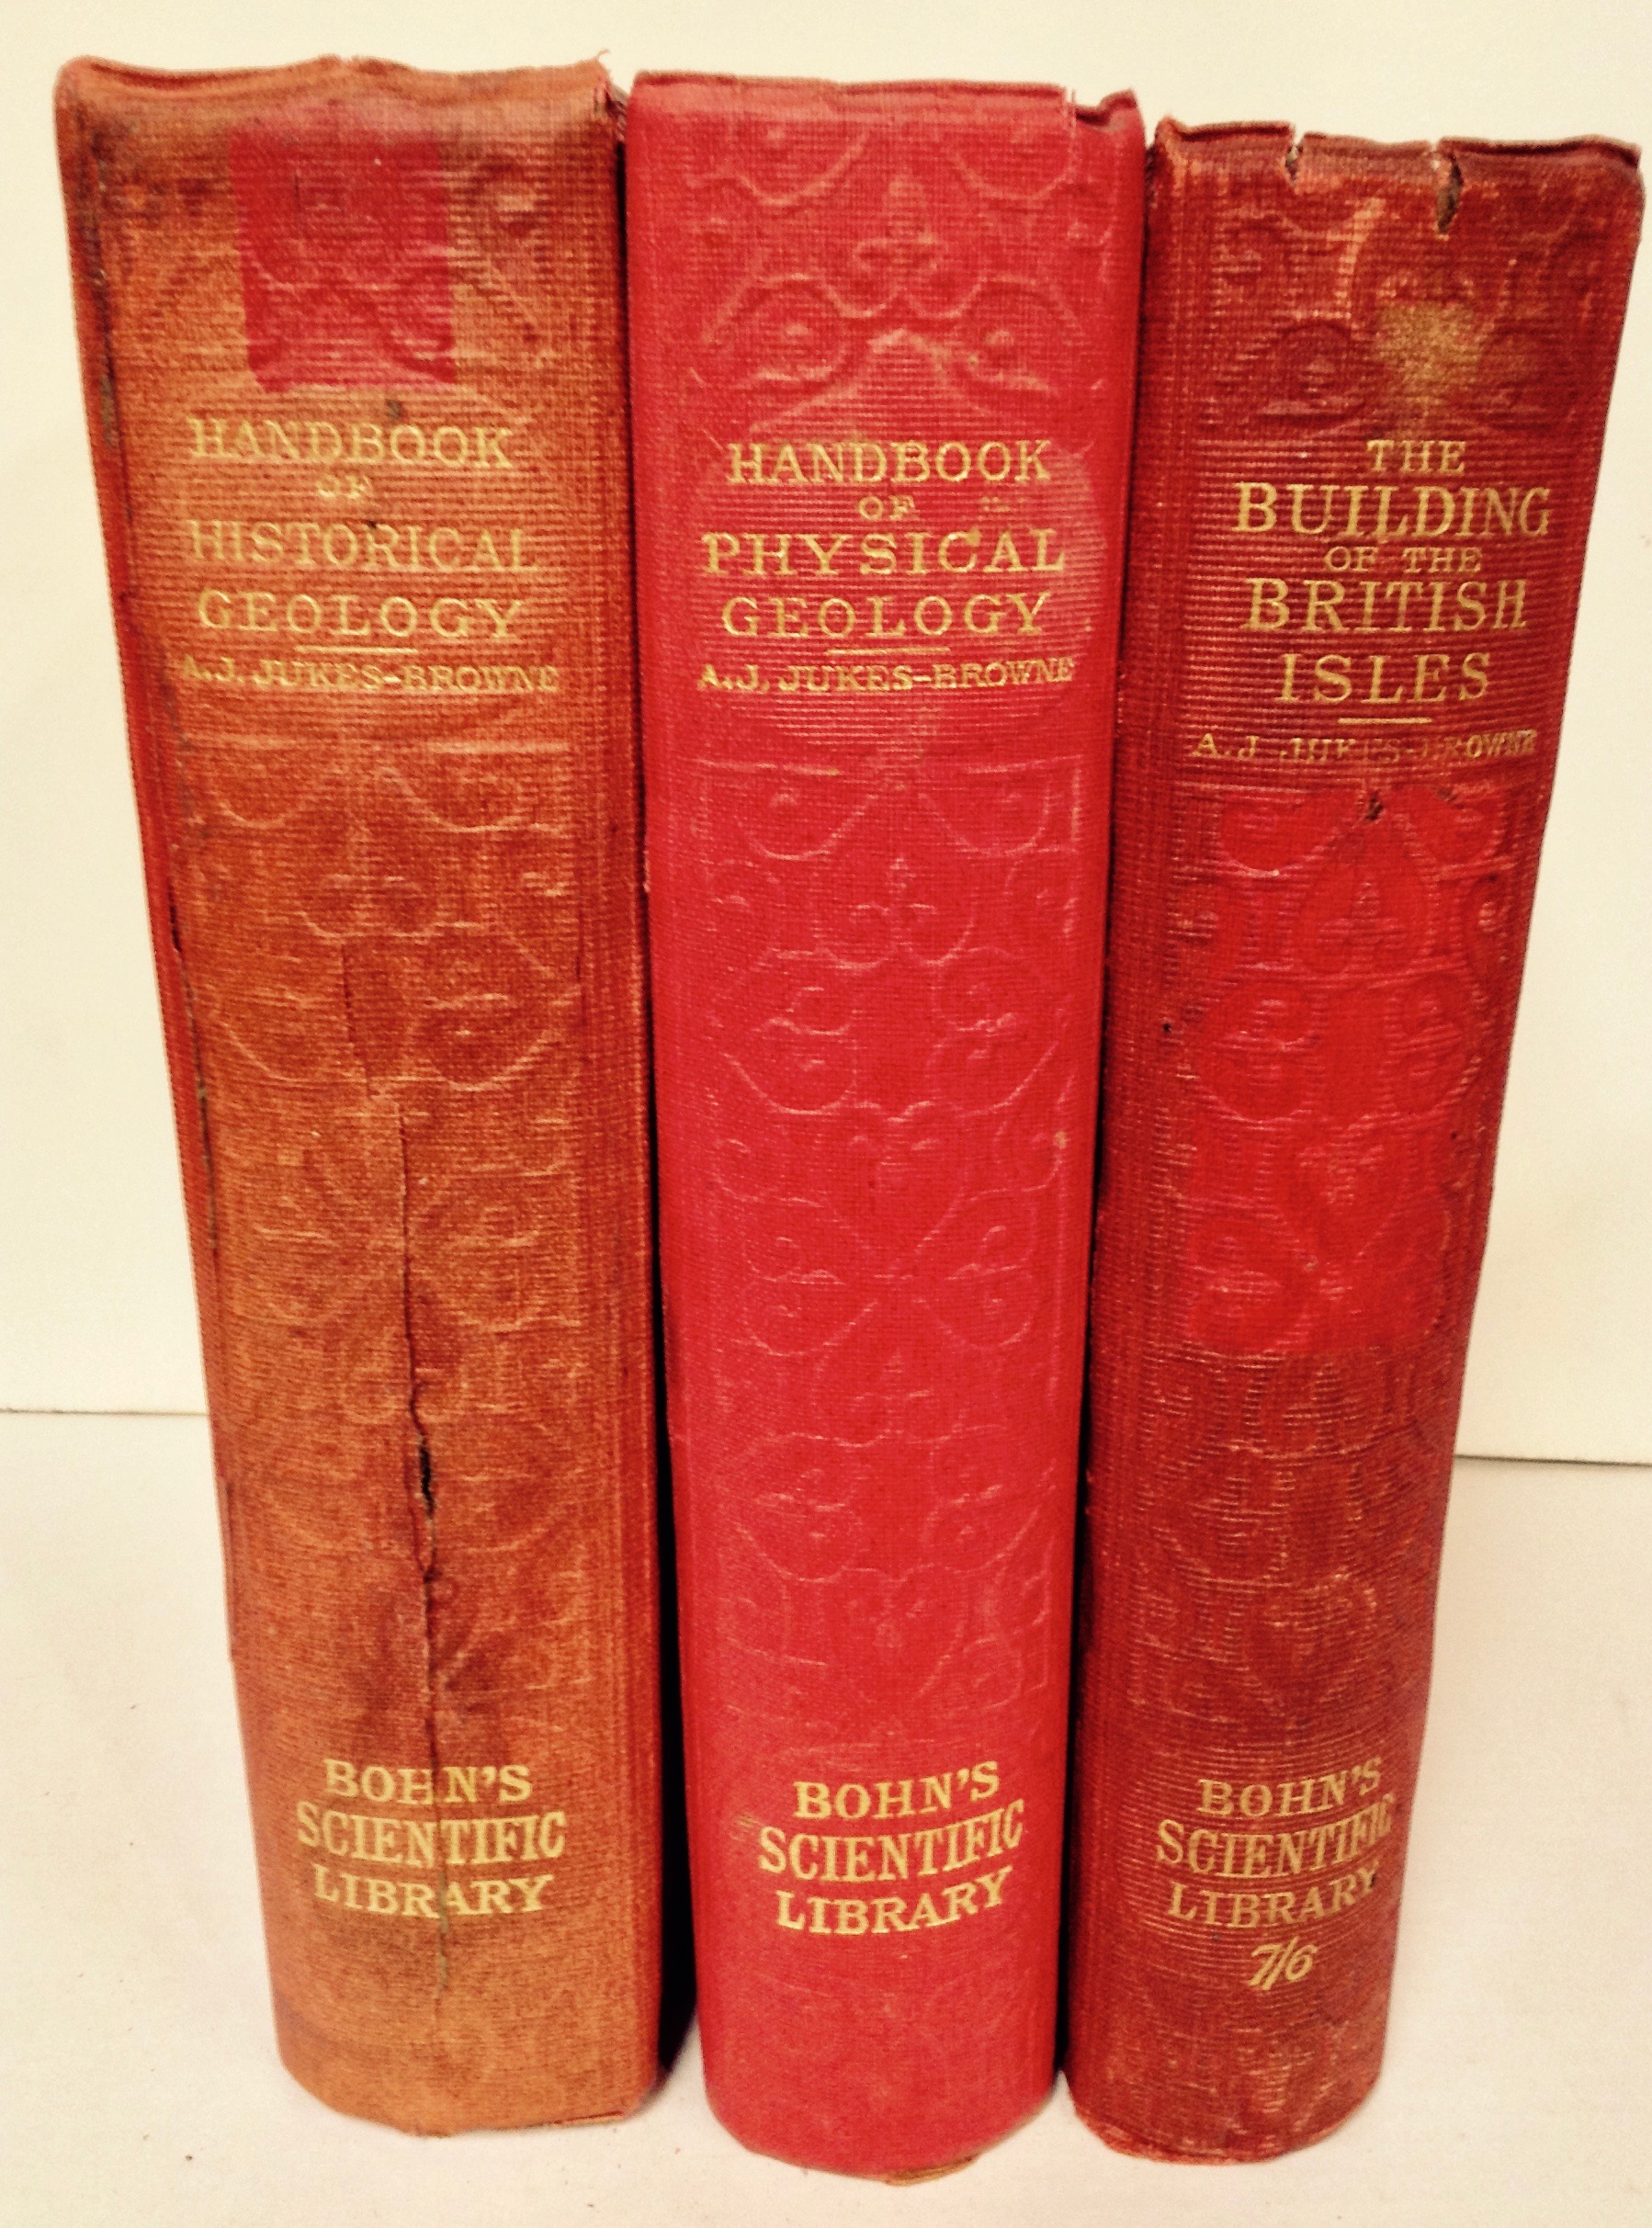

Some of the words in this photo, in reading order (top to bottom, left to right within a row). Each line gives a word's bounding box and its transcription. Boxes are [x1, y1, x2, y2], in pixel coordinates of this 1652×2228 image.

[187, 417, 514, 469] HANDBOOK
[726, 439, 1052, 484] HANDBOOK
[1366, 438, 1466, 476] THE
[315, 473, 371, 500] OF
[857, 494, 916, 521] OF
[1231, 481, 1552, 538] BUILDING
[188, 519, 540, 573] HISTORICAL
[700, 528, 1067, 576] PHYSICAL
[1325, 546, 1377, 572] OF
[1403, 546, 1483, 575] THE
[197, 589, 522, 639] GEOLOGY
[720, 591, 1052, 639] GEOLOGY
[1239, 576, 1528, 634] BRITISH
[252, 659, 560, 695] JUKES-BROWNE
[778, 656, 1074, 694] JUKES-BROWNE
[1273, 651, 1491, 704] ISLES
[322, 1758, 533, 1806] BOHN'S
[792, 1759, 1001, 1820] BOHN'S
[1196, 1756, 1382, 1818] BOHN'S
[295, 1800, 567, 1869] SCIENTIFIC
[758, 1798, 1025, 1883] SCIENTIFIC
[1155, 1793, 1396, 1879] SCIENTIFIC
[311, 1861, 554, 1919] LIBRARY
[775, 1864, 1013, 1936] LIBRARY
[1167, 1858, 1380, 1928] LIBRARY
[1247, 1935, 1318, 1992] 7/6
